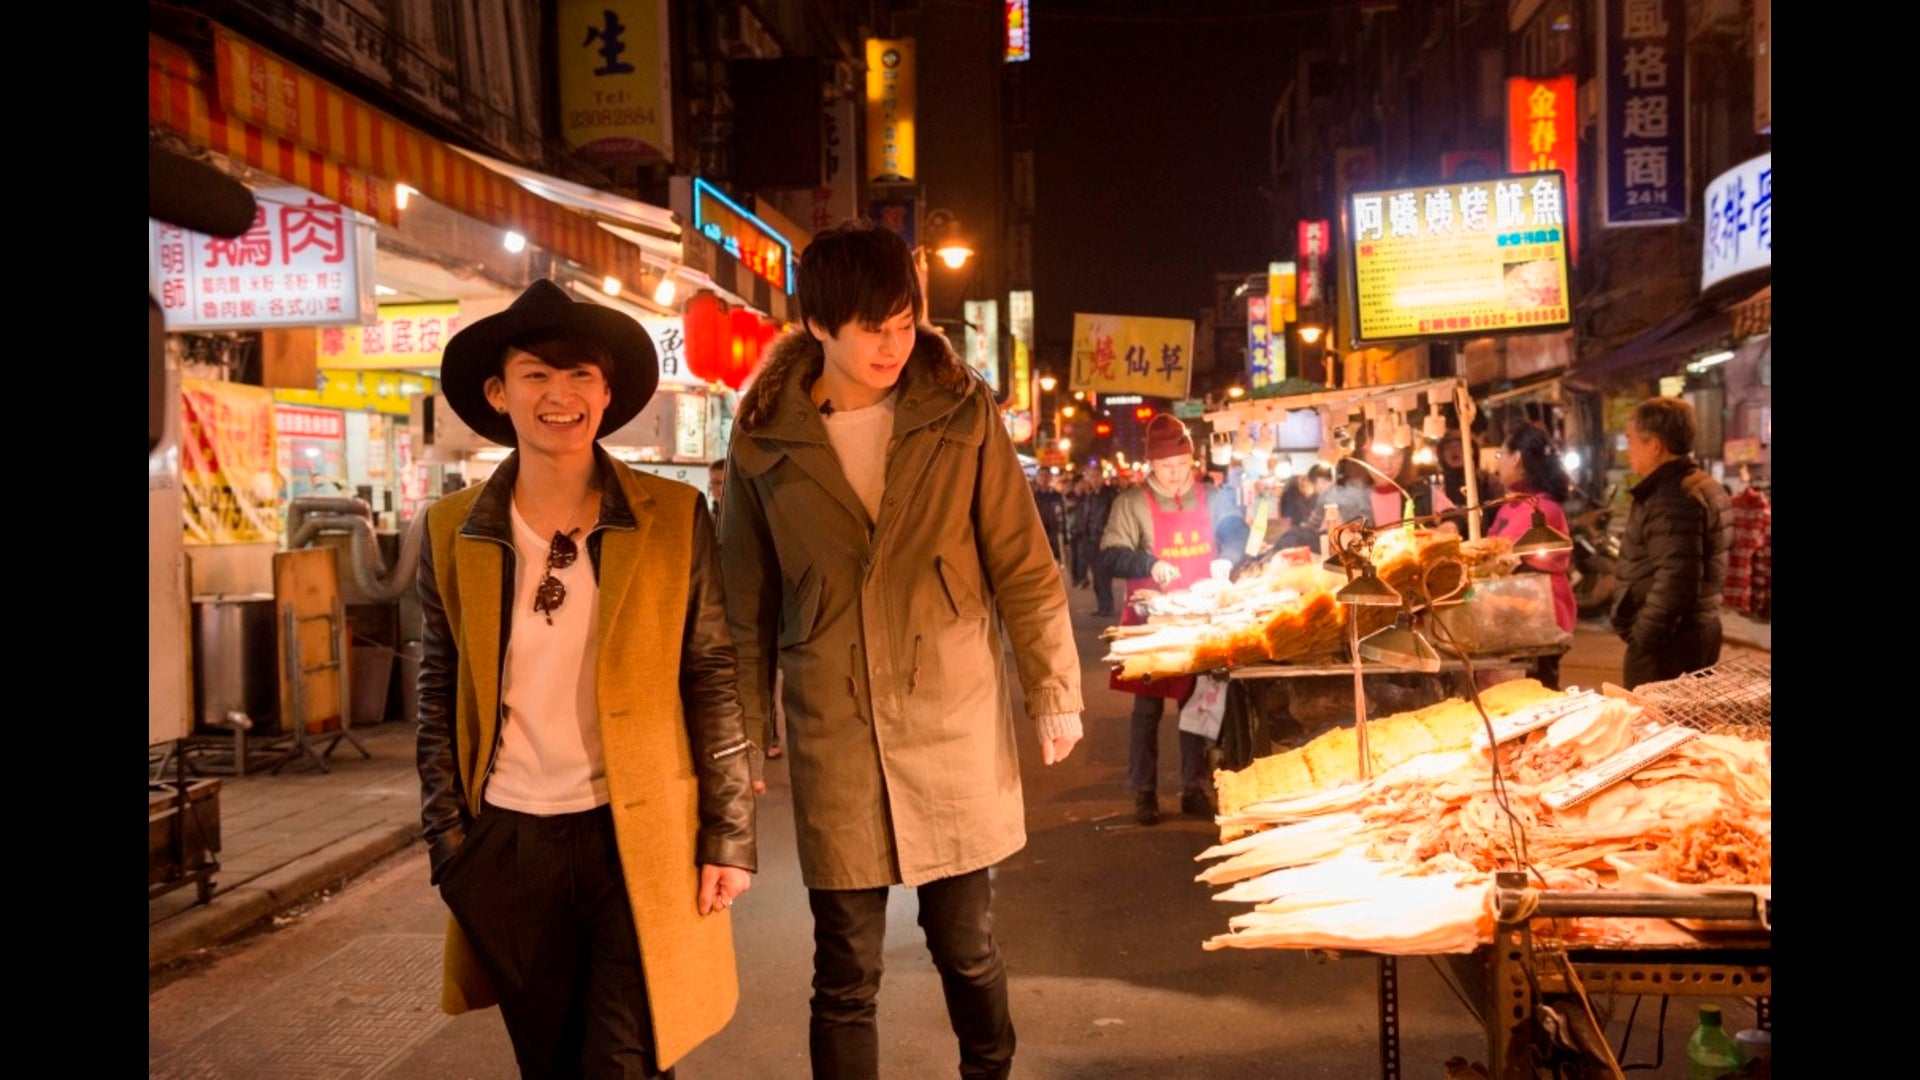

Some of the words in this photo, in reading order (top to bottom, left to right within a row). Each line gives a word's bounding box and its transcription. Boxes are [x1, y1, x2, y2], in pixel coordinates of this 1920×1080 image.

[582, 10, 634, 76] 生
[1623, 0, 1668, 189] 風格超商
[1626, 190, 1668, 205] 24H
[1090, 335, 1184, 381] 燒仙草
